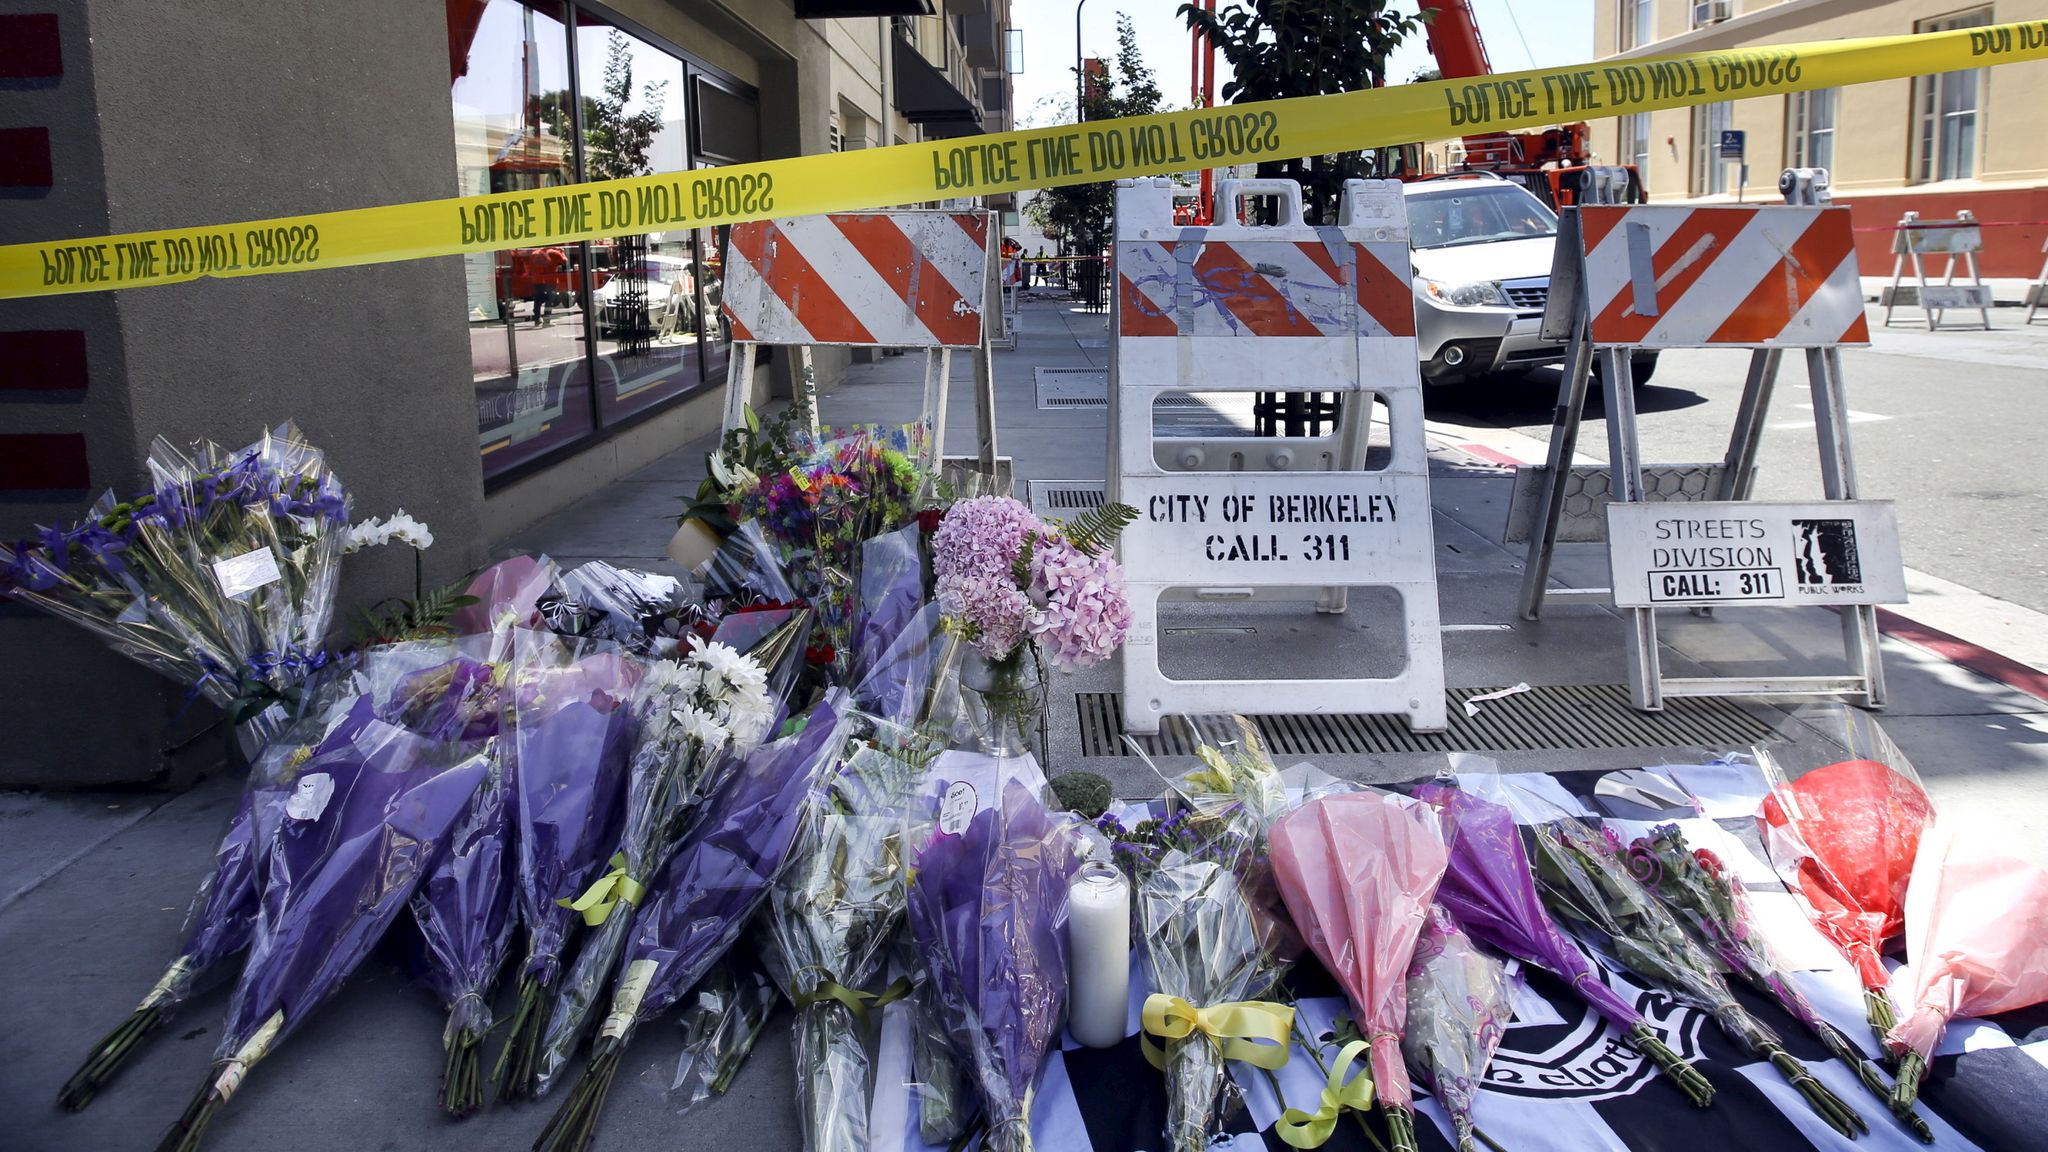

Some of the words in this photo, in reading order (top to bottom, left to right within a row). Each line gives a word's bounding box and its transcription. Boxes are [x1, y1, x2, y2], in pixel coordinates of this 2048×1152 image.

[1149, 495, 1209, 523] CITY
[1222, 495, 1256, 523] OF
[1269, 494, 1397, 523] BERKELEY
[1655, 519, 1766, 540] STREETS
[1205, 534, 1289, 562] CALL
[1303, 534, 1350, 562] 311
[1653, 547, 1773, 569] DIVISION
[1663, 574, 1721, 597] CALL:
[1740, 573, 1771, 596] 311
[1799, 585, 1829, 595] PUBLIC
[1832, 585, 1865, 594] WORKS
